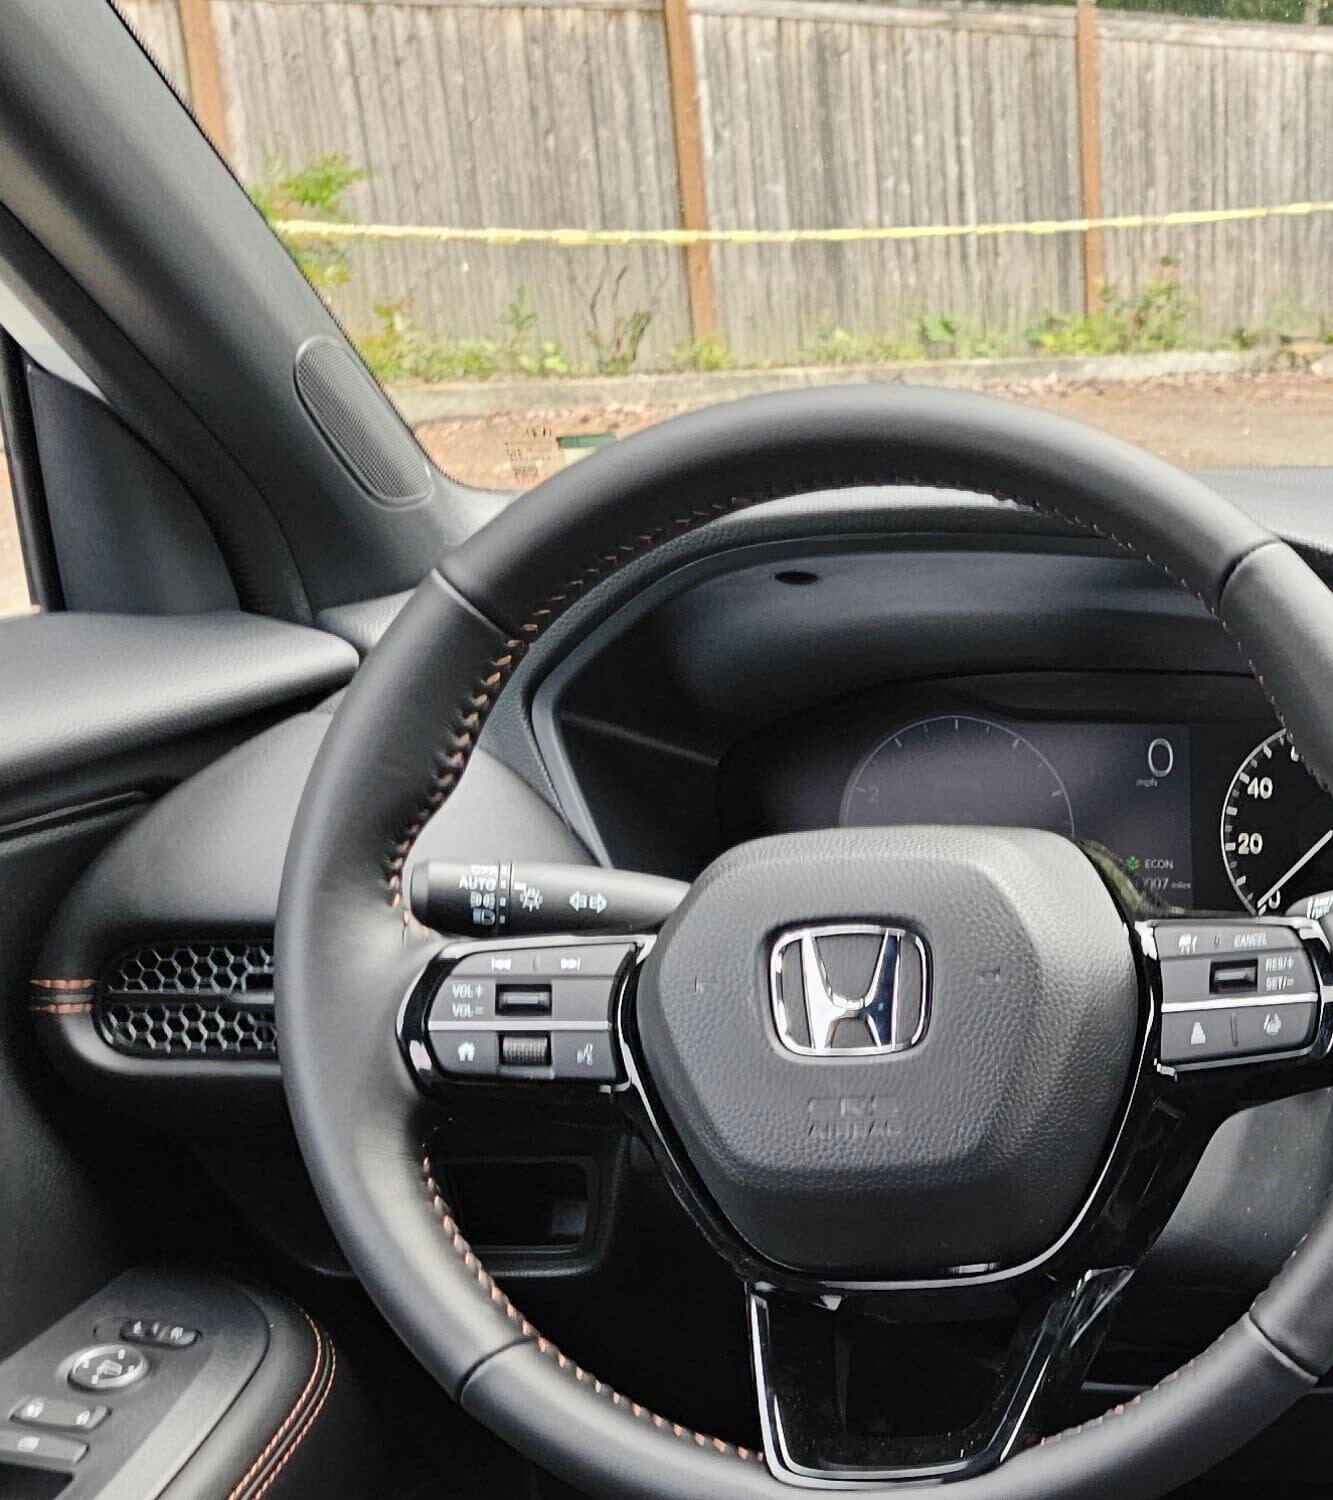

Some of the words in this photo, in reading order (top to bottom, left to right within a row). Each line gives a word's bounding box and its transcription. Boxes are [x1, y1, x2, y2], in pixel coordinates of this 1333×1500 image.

[1148, 738, 1174, 777] 0
[1136, 778, 1158, 788] mph
[1247, 777, 1273, 800] 40
[1238, 833, 1263, 855] 20
[1145, 858, 1174, 870] ECON
[459, 875, 496, 891] AUTO
